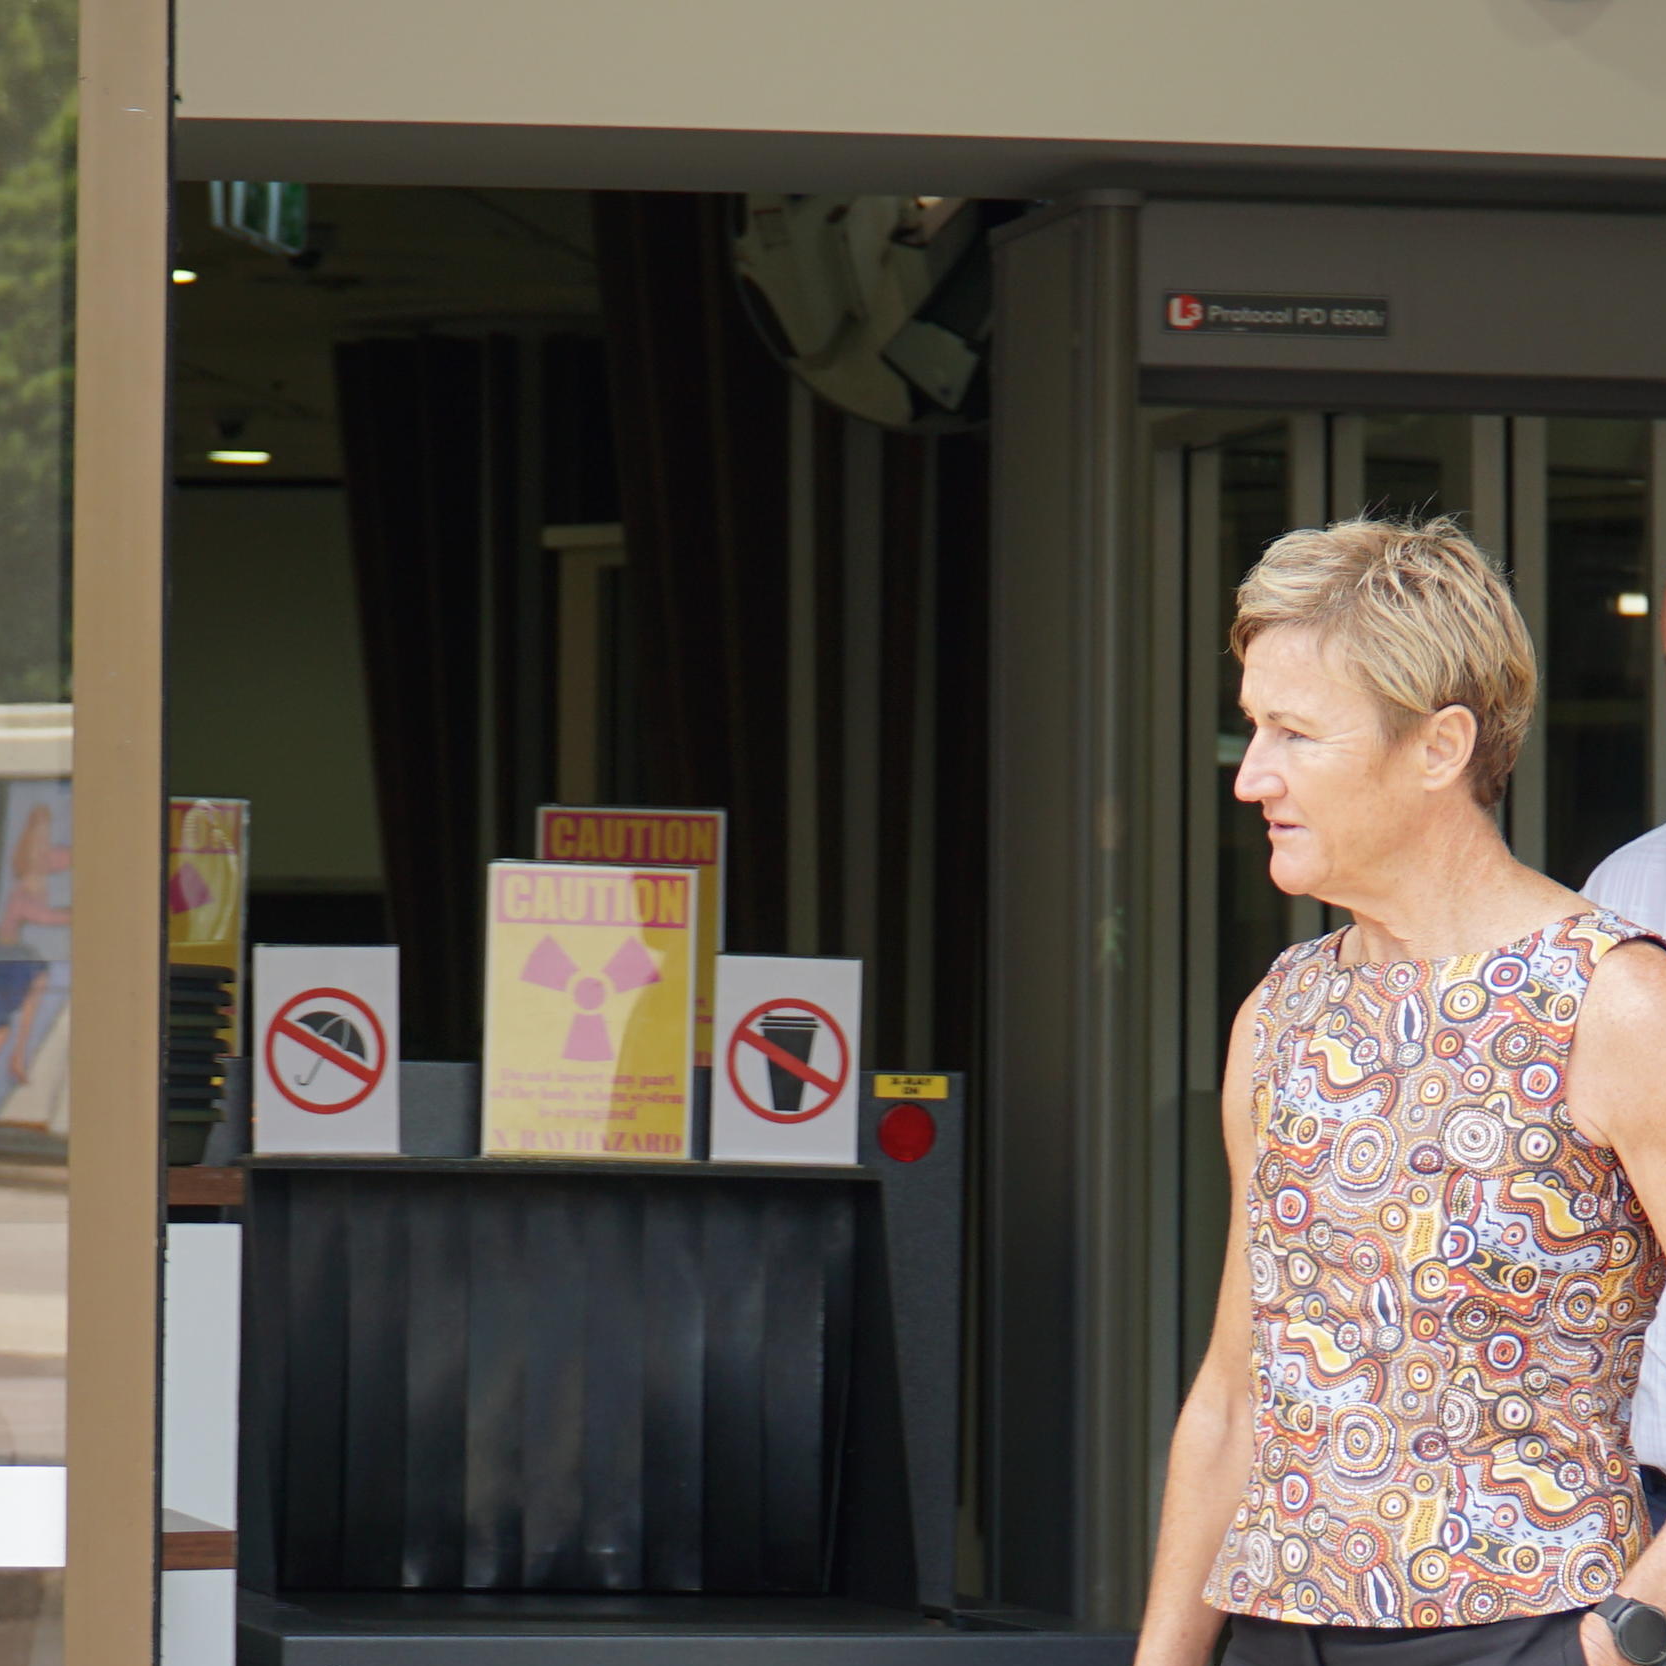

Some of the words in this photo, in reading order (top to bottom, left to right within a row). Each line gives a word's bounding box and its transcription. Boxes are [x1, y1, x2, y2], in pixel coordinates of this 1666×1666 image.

[1208, 305, 1292, 324] Protocol
[1297, 308, 1326, 325] PD
[550, 817, 713, 861] CAUTION
[503, 874, 685, 925] CAUTION
